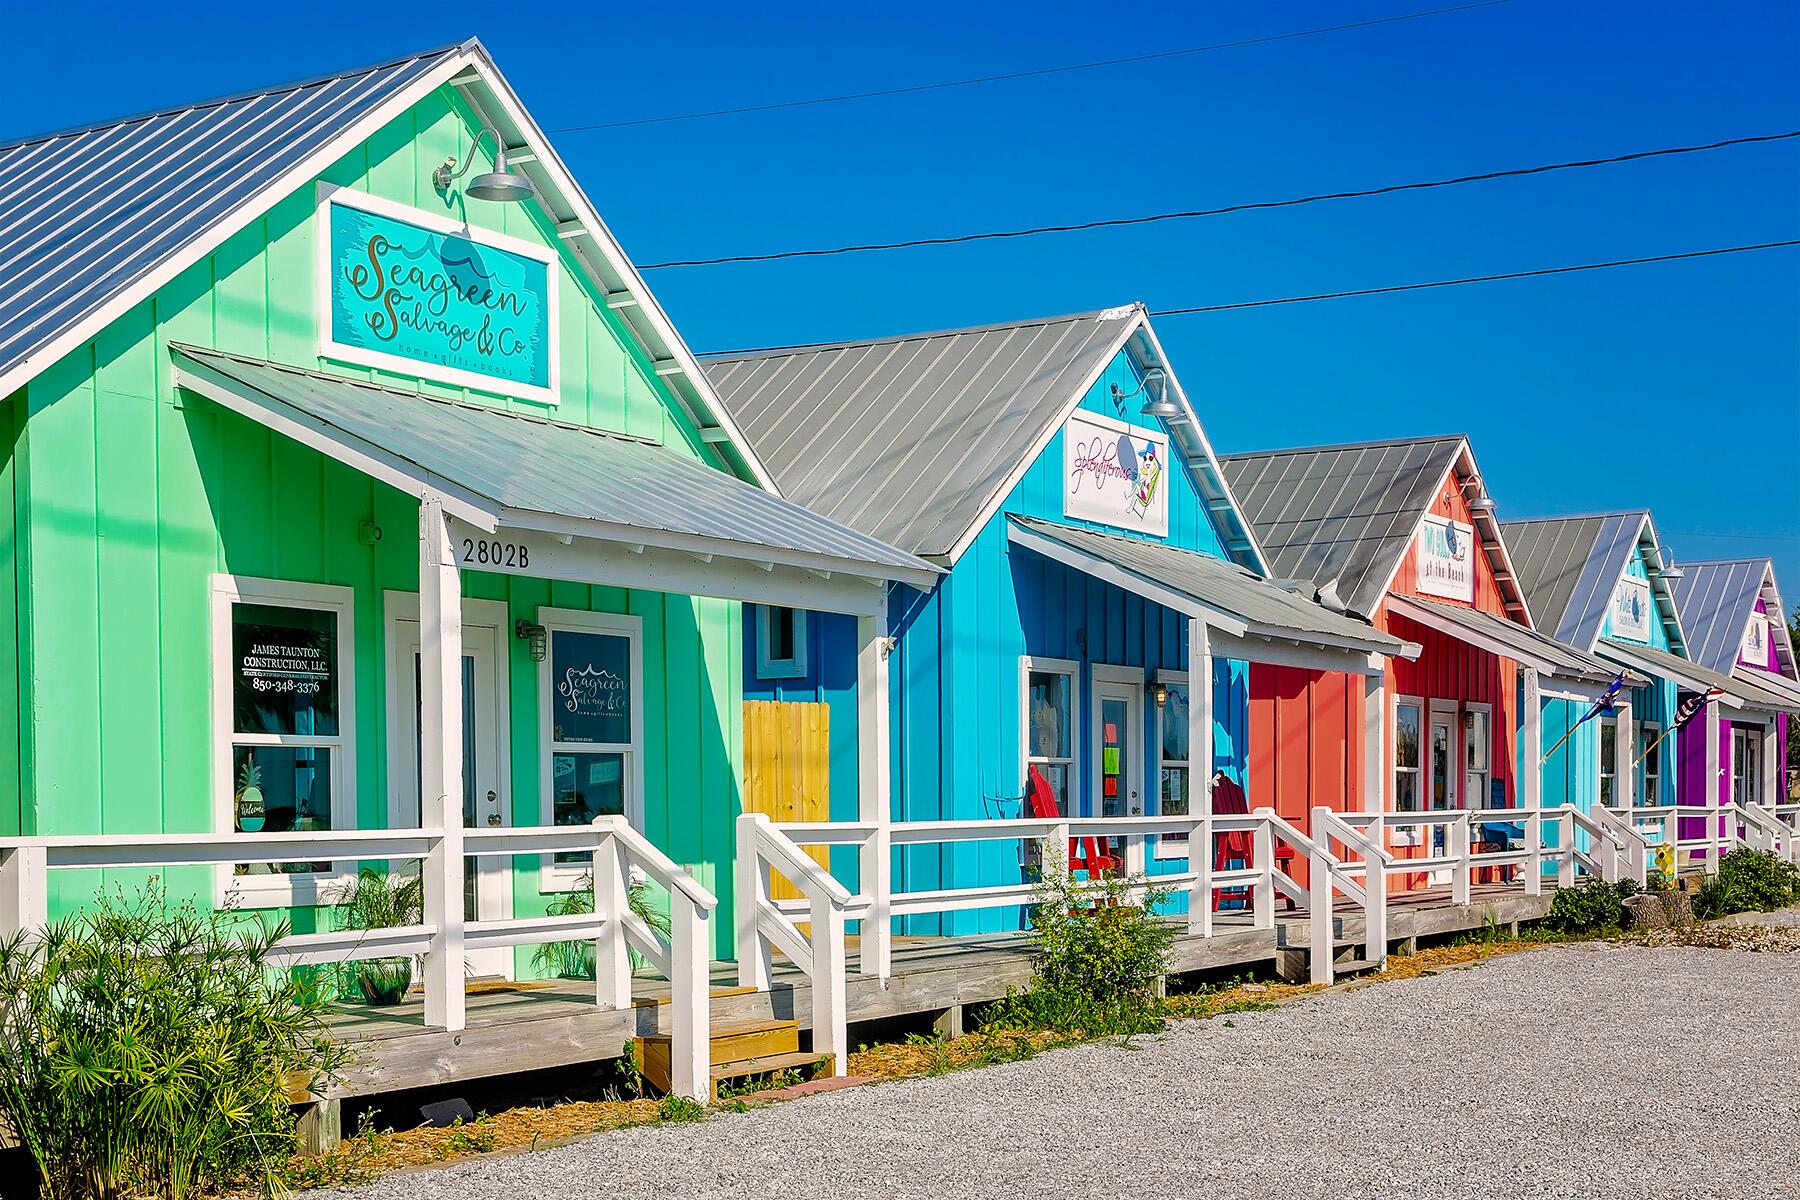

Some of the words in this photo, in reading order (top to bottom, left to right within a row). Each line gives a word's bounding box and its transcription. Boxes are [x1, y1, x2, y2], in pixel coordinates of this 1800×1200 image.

[345, 234, 527, 316] Seagreen
[365, 288, 476, 351] Salvage
[477, 313, 495, 356] &
[398, 343, 428, 358] home
[441, 354, 468, 366] gifts
[481, 363, 513, 376] books
[463, 538, 529, 568] 2802B
[243, 656, 310, 671] CONSTRUCTION,
[311, 660, 328, 671] LLC.
[251, 643, 280, 656] JAMES
[281, 646, 320, 658] TAUNTON
[252, 677, 320, 693] 850-348-3376
[557, 667, 628, 697] Seagreen
[565, 688, 606, 712] Salvage
[240, 803, 265, 816] Welcome
